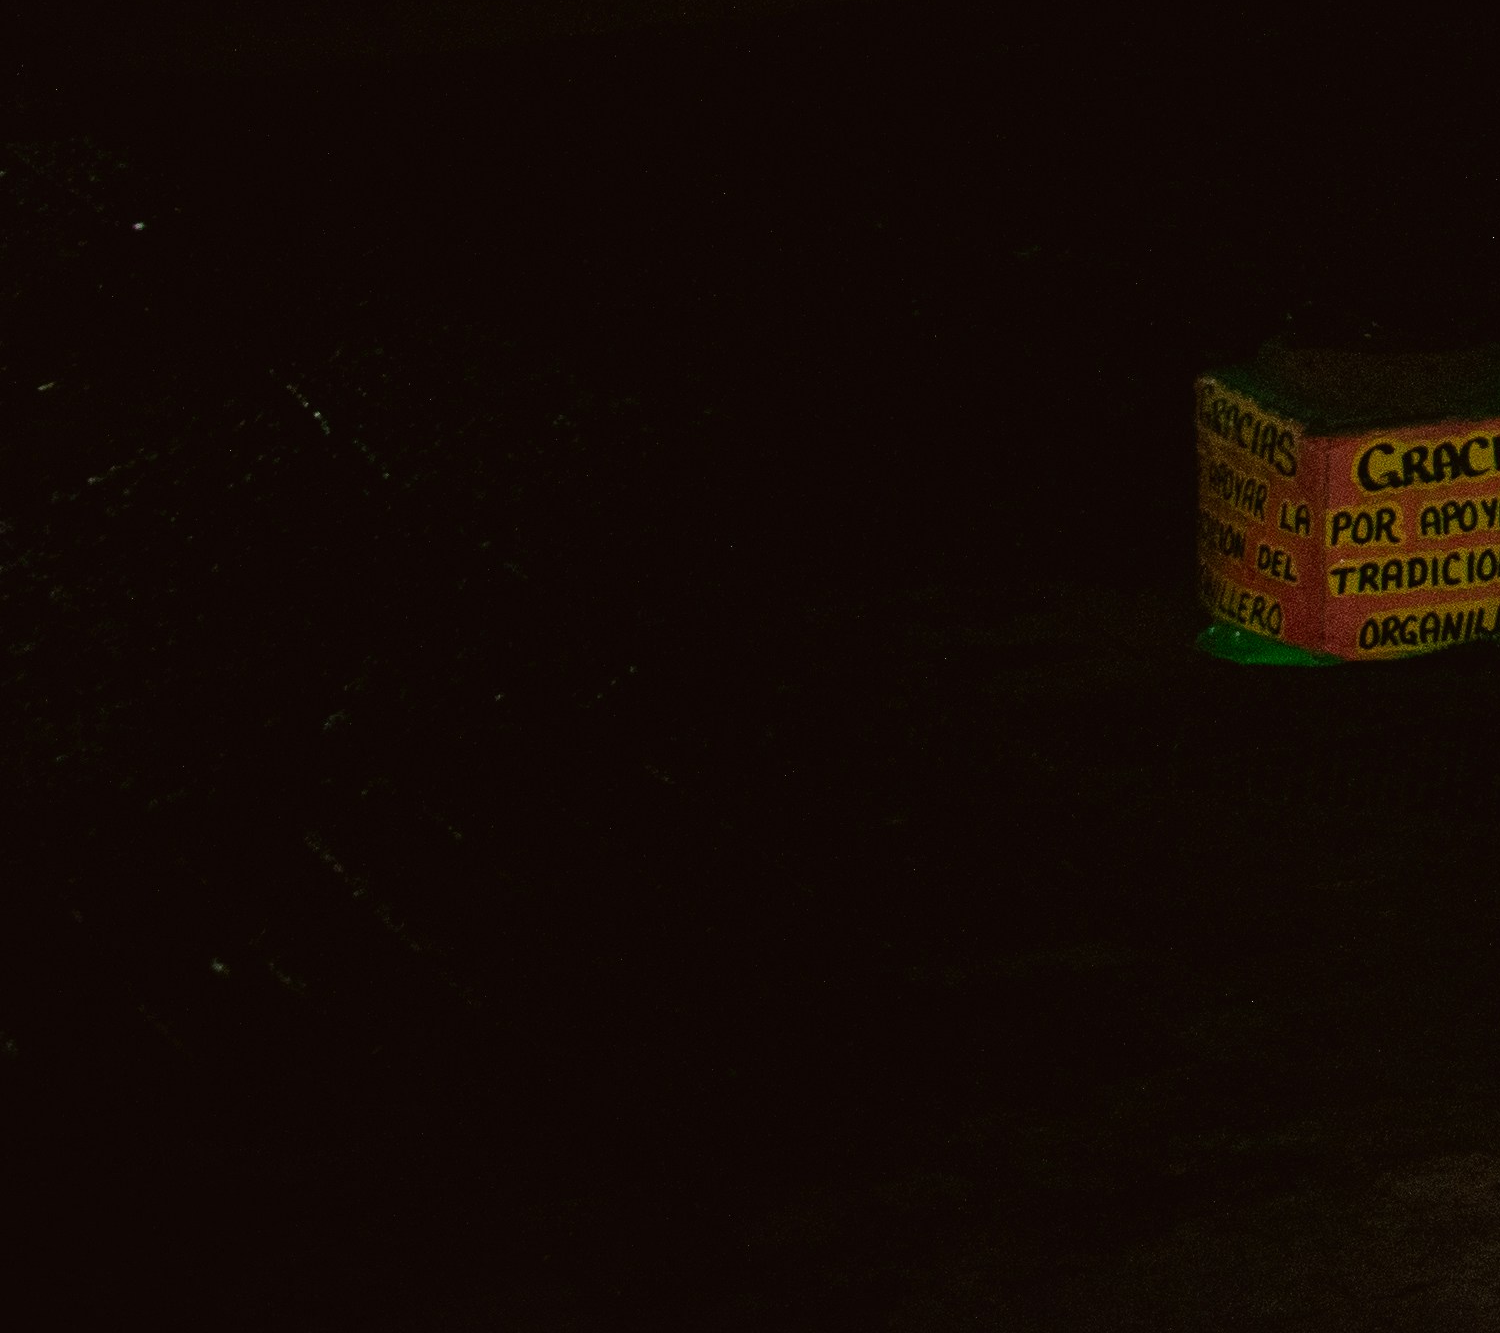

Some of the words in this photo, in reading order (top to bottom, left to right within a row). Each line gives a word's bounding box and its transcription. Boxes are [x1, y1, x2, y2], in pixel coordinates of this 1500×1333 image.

[1279, 501, 1311, 535] LA
[1331, 508, 1399, 546] POR
[1257, 544, 1297, 581] DEL
